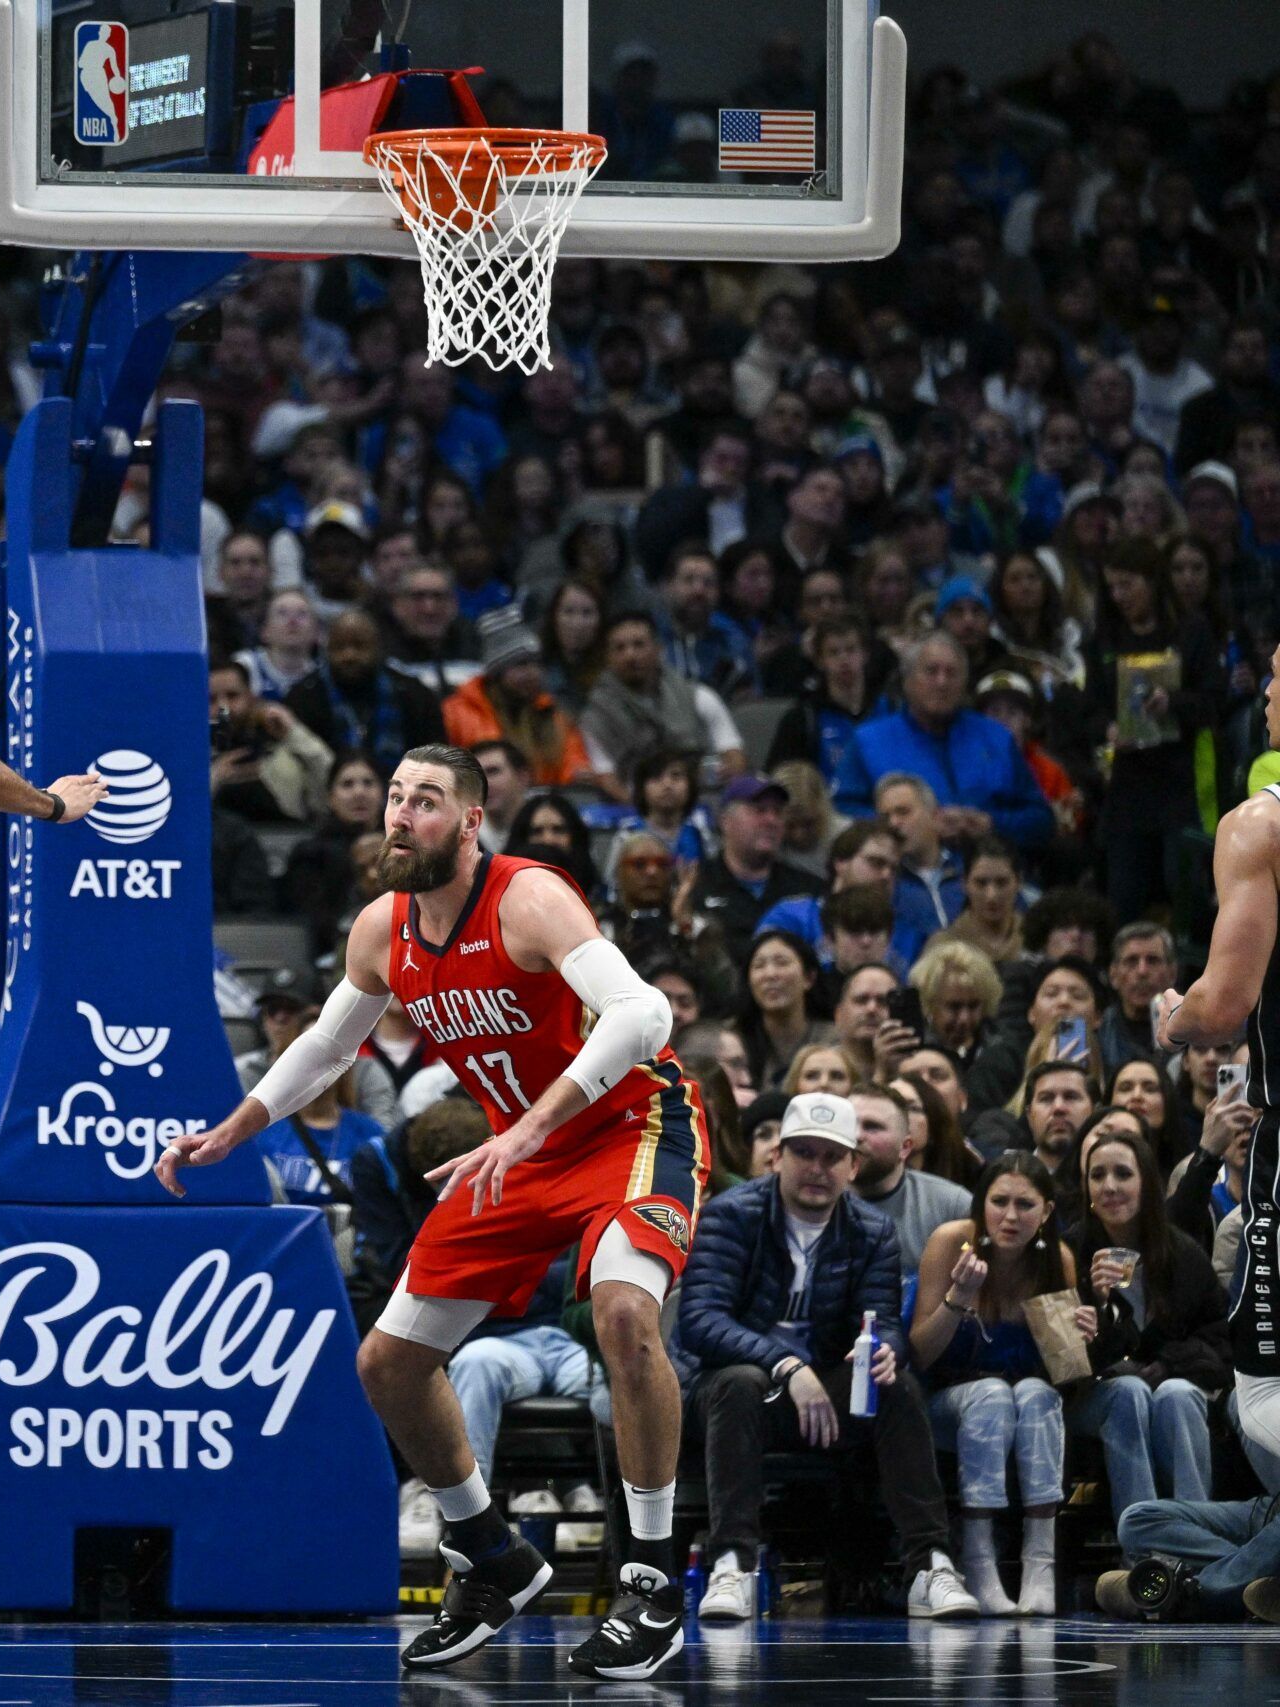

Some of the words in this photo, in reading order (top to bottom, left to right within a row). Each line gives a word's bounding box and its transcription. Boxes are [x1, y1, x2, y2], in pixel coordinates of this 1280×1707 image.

[83, 118, 108, 138] NBA
[24, 627, 34, 769] RESORTS
[4, 609, 21, 1005] CHOTAW
[70, 860, 182, 899] AT&T
[459, 939, 490, 955] ibotta
[405, 988, 533, 1045] PELICANS
[465, 1049, 532, 1114] 17
[37, 1081, 207, 1179] Kroger
[9, 1407, 234, 1471] SPORTS
